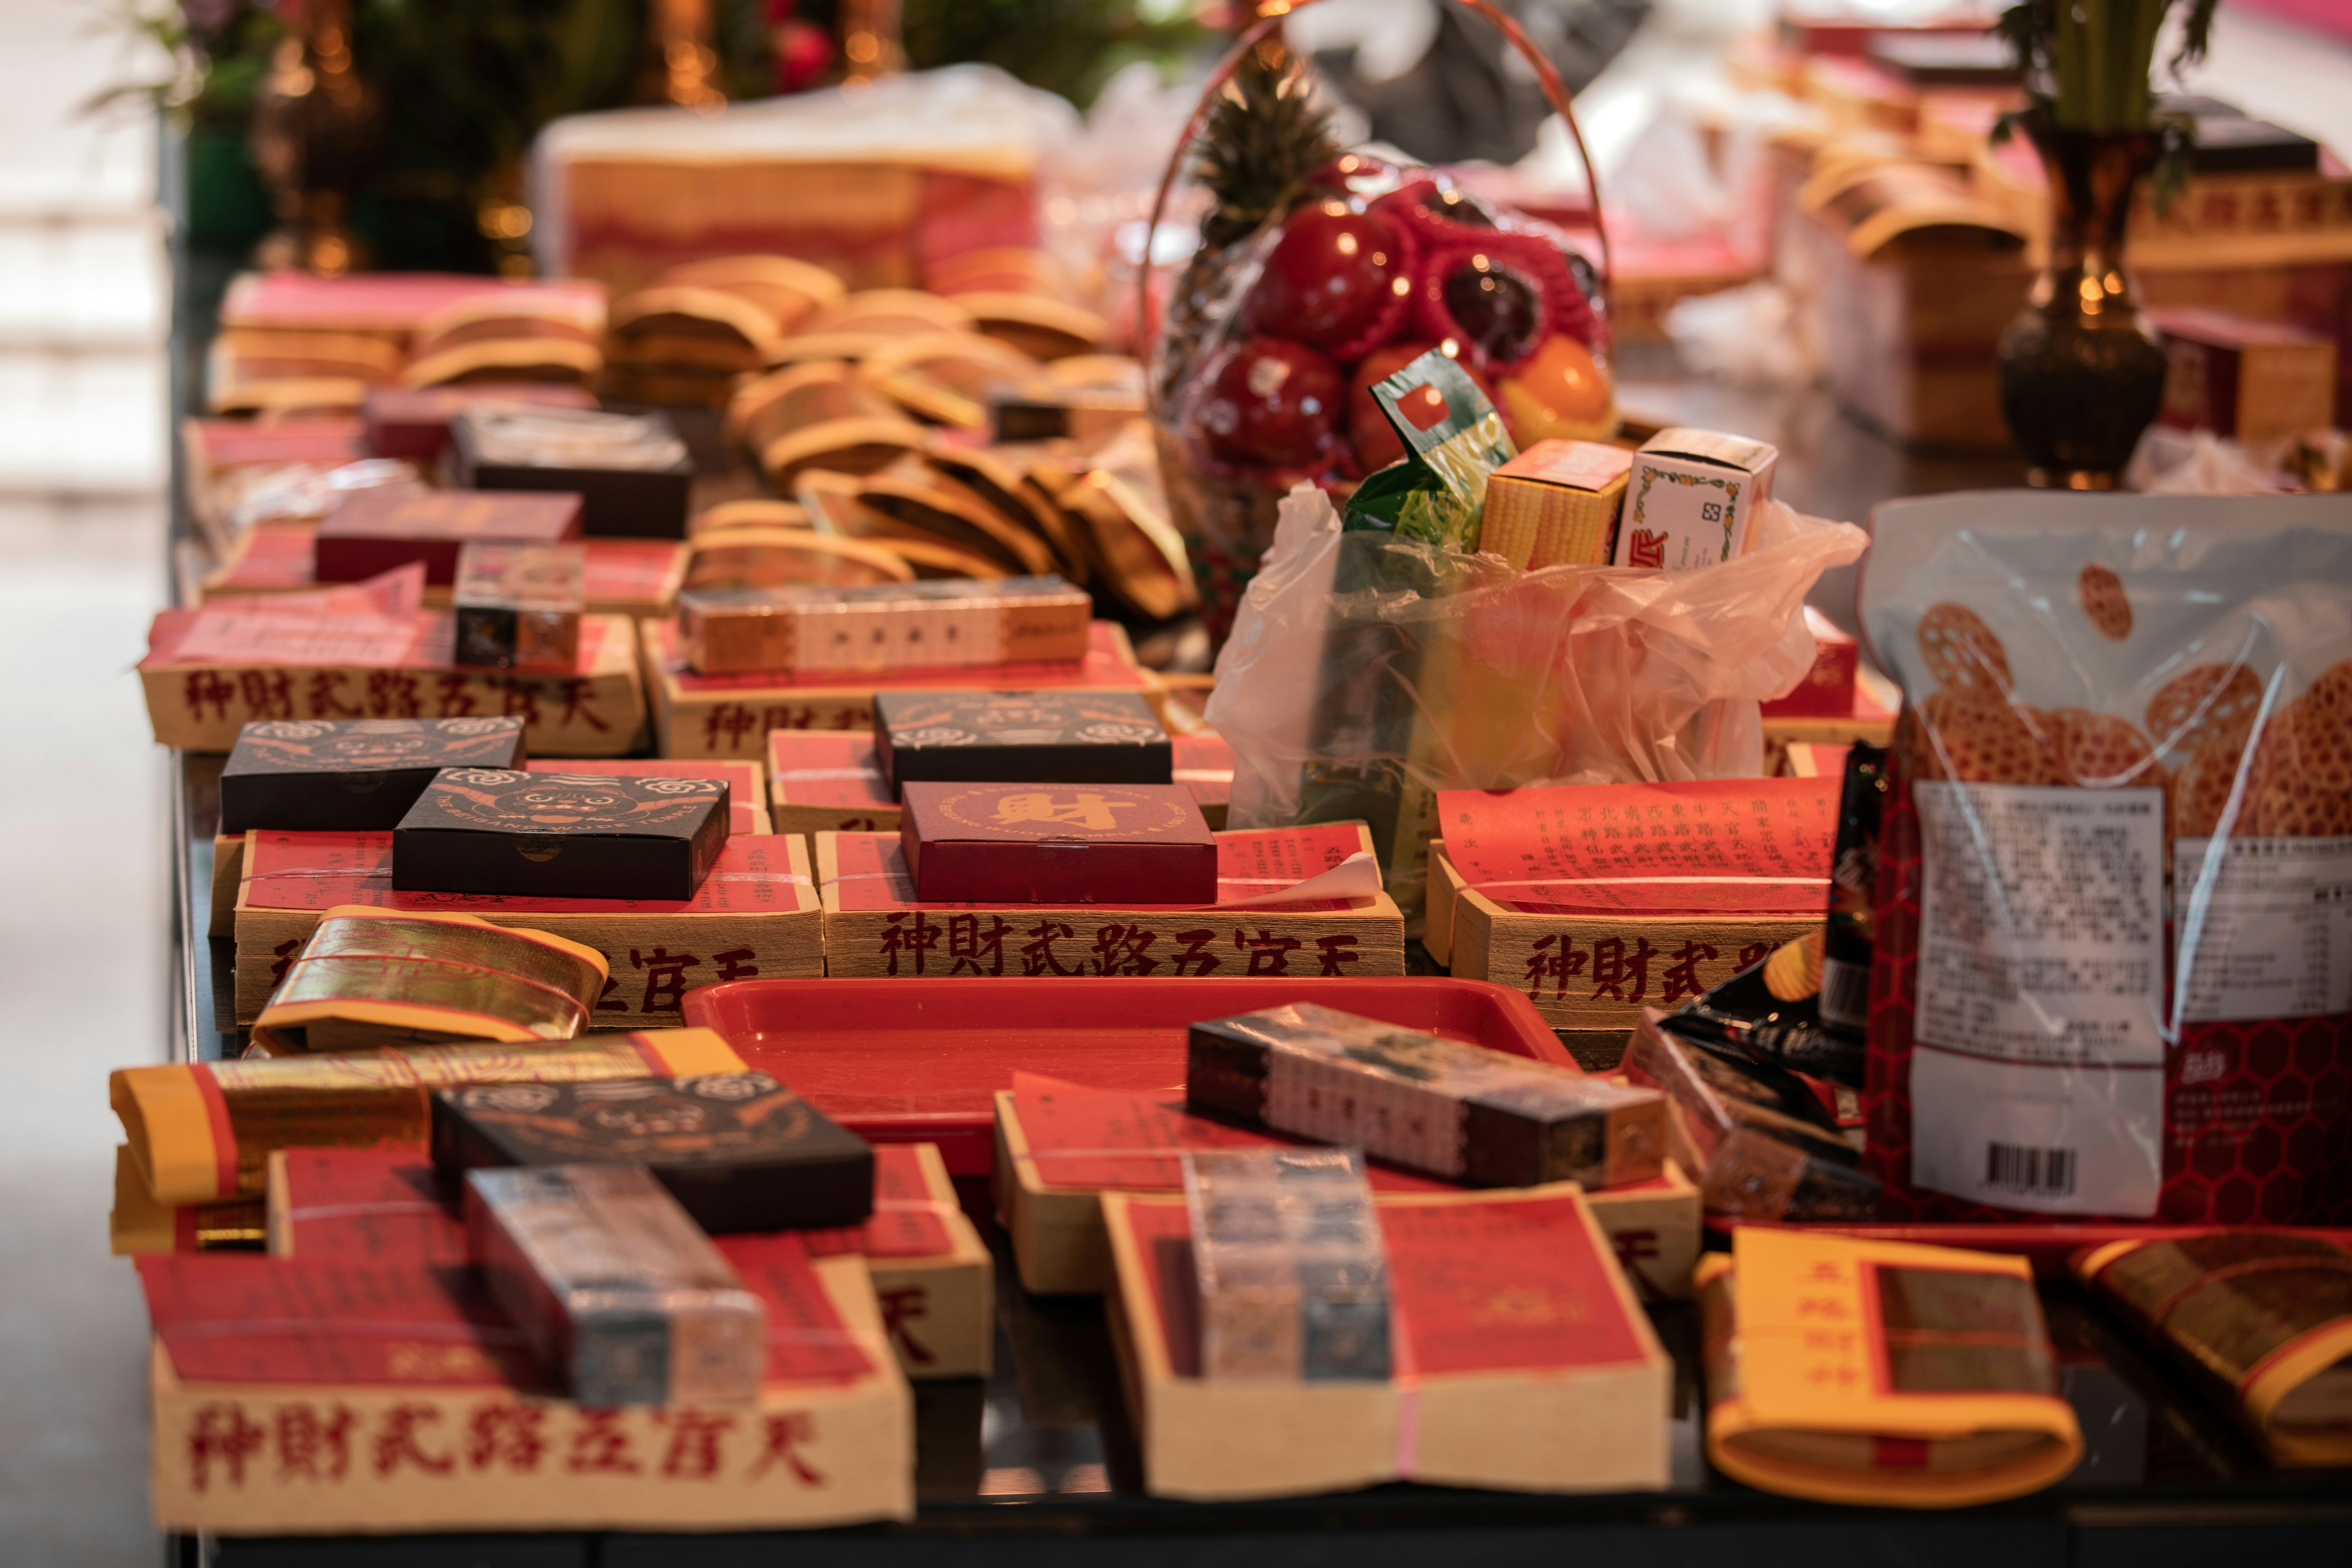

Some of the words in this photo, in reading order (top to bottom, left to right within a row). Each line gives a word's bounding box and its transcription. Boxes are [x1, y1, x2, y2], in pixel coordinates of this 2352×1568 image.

[436, 795, 453, 807] THE
[445, 809, 539, 829] BEIGANG
[635, 804, 698, 825] TEMPLE
[939, 805, 983, 827] BEIGANG
[985, 826, 1050, 836] WUDE
[1055, 829, 1145, 838] TEMPLE
